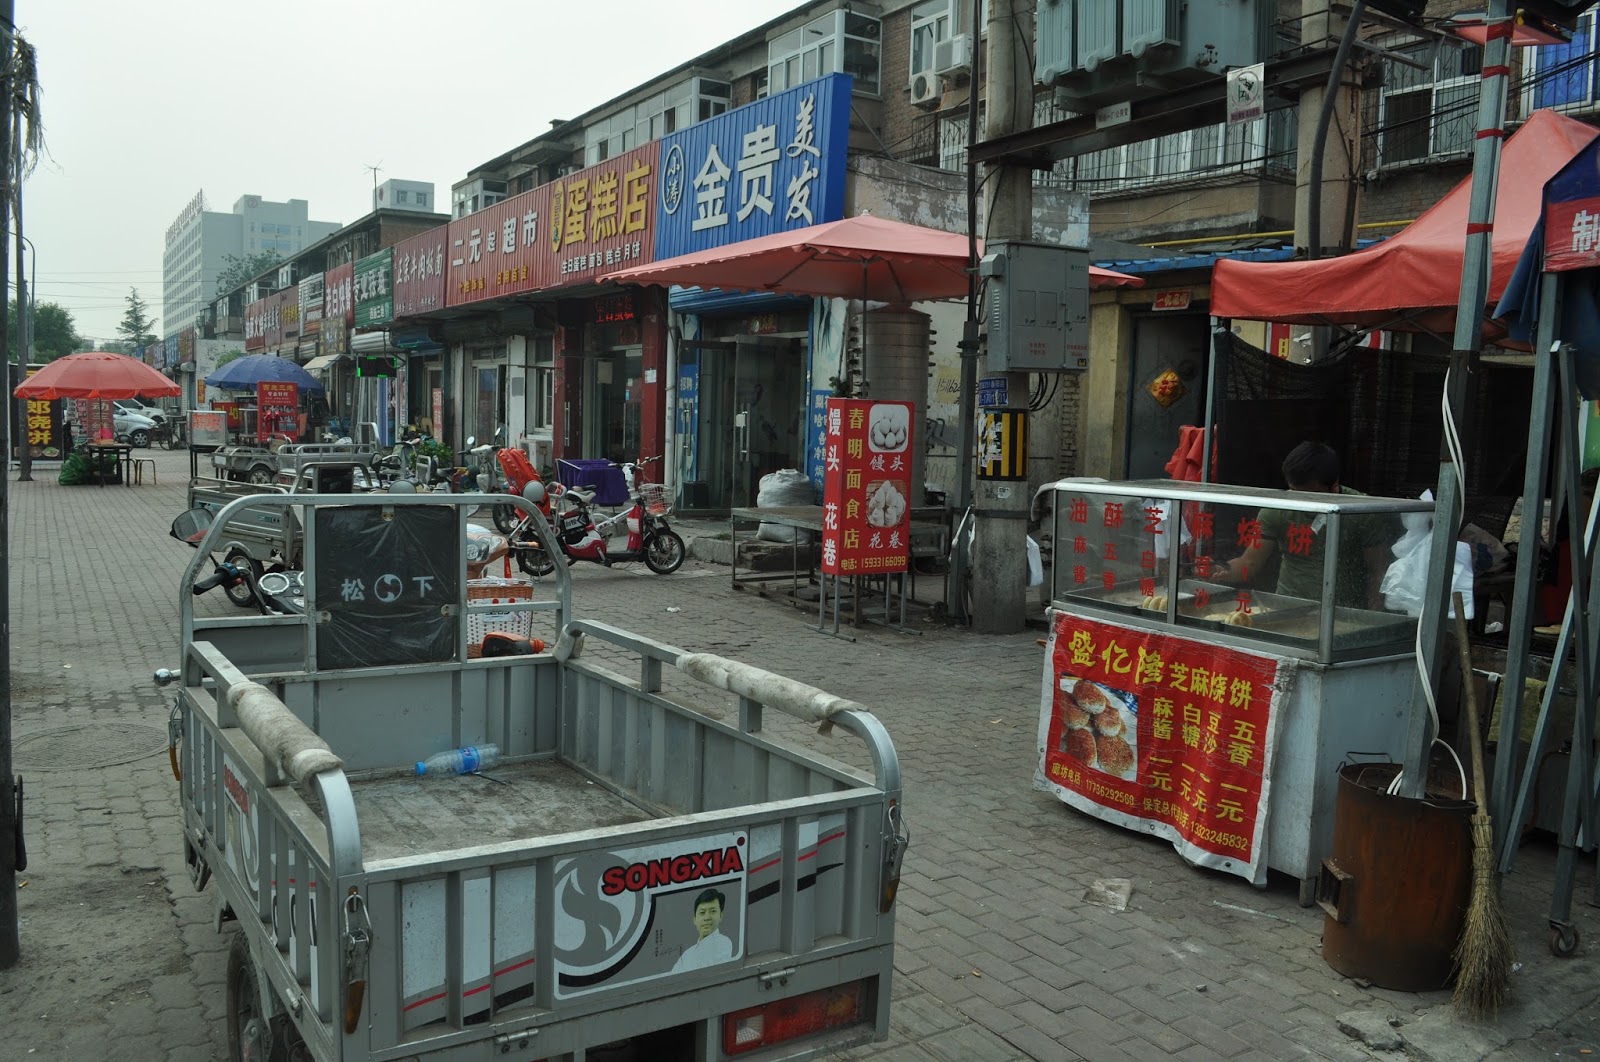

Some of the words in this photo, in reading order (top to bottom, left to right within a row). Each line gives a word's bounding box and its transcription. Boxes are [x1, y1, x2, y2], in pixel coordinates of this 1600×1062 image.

[692, 123, 781, 232] 金贵
[785, 92, 822, 226] 美发
[564, 158, 652, 246] 蛋糕店
[452, 209, 539, 268] 二元起超市
[827, 408, 841, 472] 馒头
[869, 455, 904, 472] 馒头
[844, 408, 864, 550] 春明面食店
[823, 502, 838, 567] 花卷
[868, 531, 904, 549] 花卷
[1069, 497, 1312, 556] 油酥芝麻烧饼
[861, 555, 906, 568] 15933166099
[1068, 630, 1165, 685] 盛亿隆
[1169, 661, 1252, 711] 芝麻烧饼
[1153, 697, 1174, 741] 麻酱
[1182, 702, 1201, 749] 白糖
[1203, 710, 1221, 755] 豆沙
[1228, 719, 1256, 767] 五香
[1150, 757, 1172, 792] 一元
[1180, 763, 1195, 801] 一元
[1192, 773, 1210, 814] 一元
[1216, 783, 1248, 823] 一元
[600, 845, 744, 897] SONGXIA
